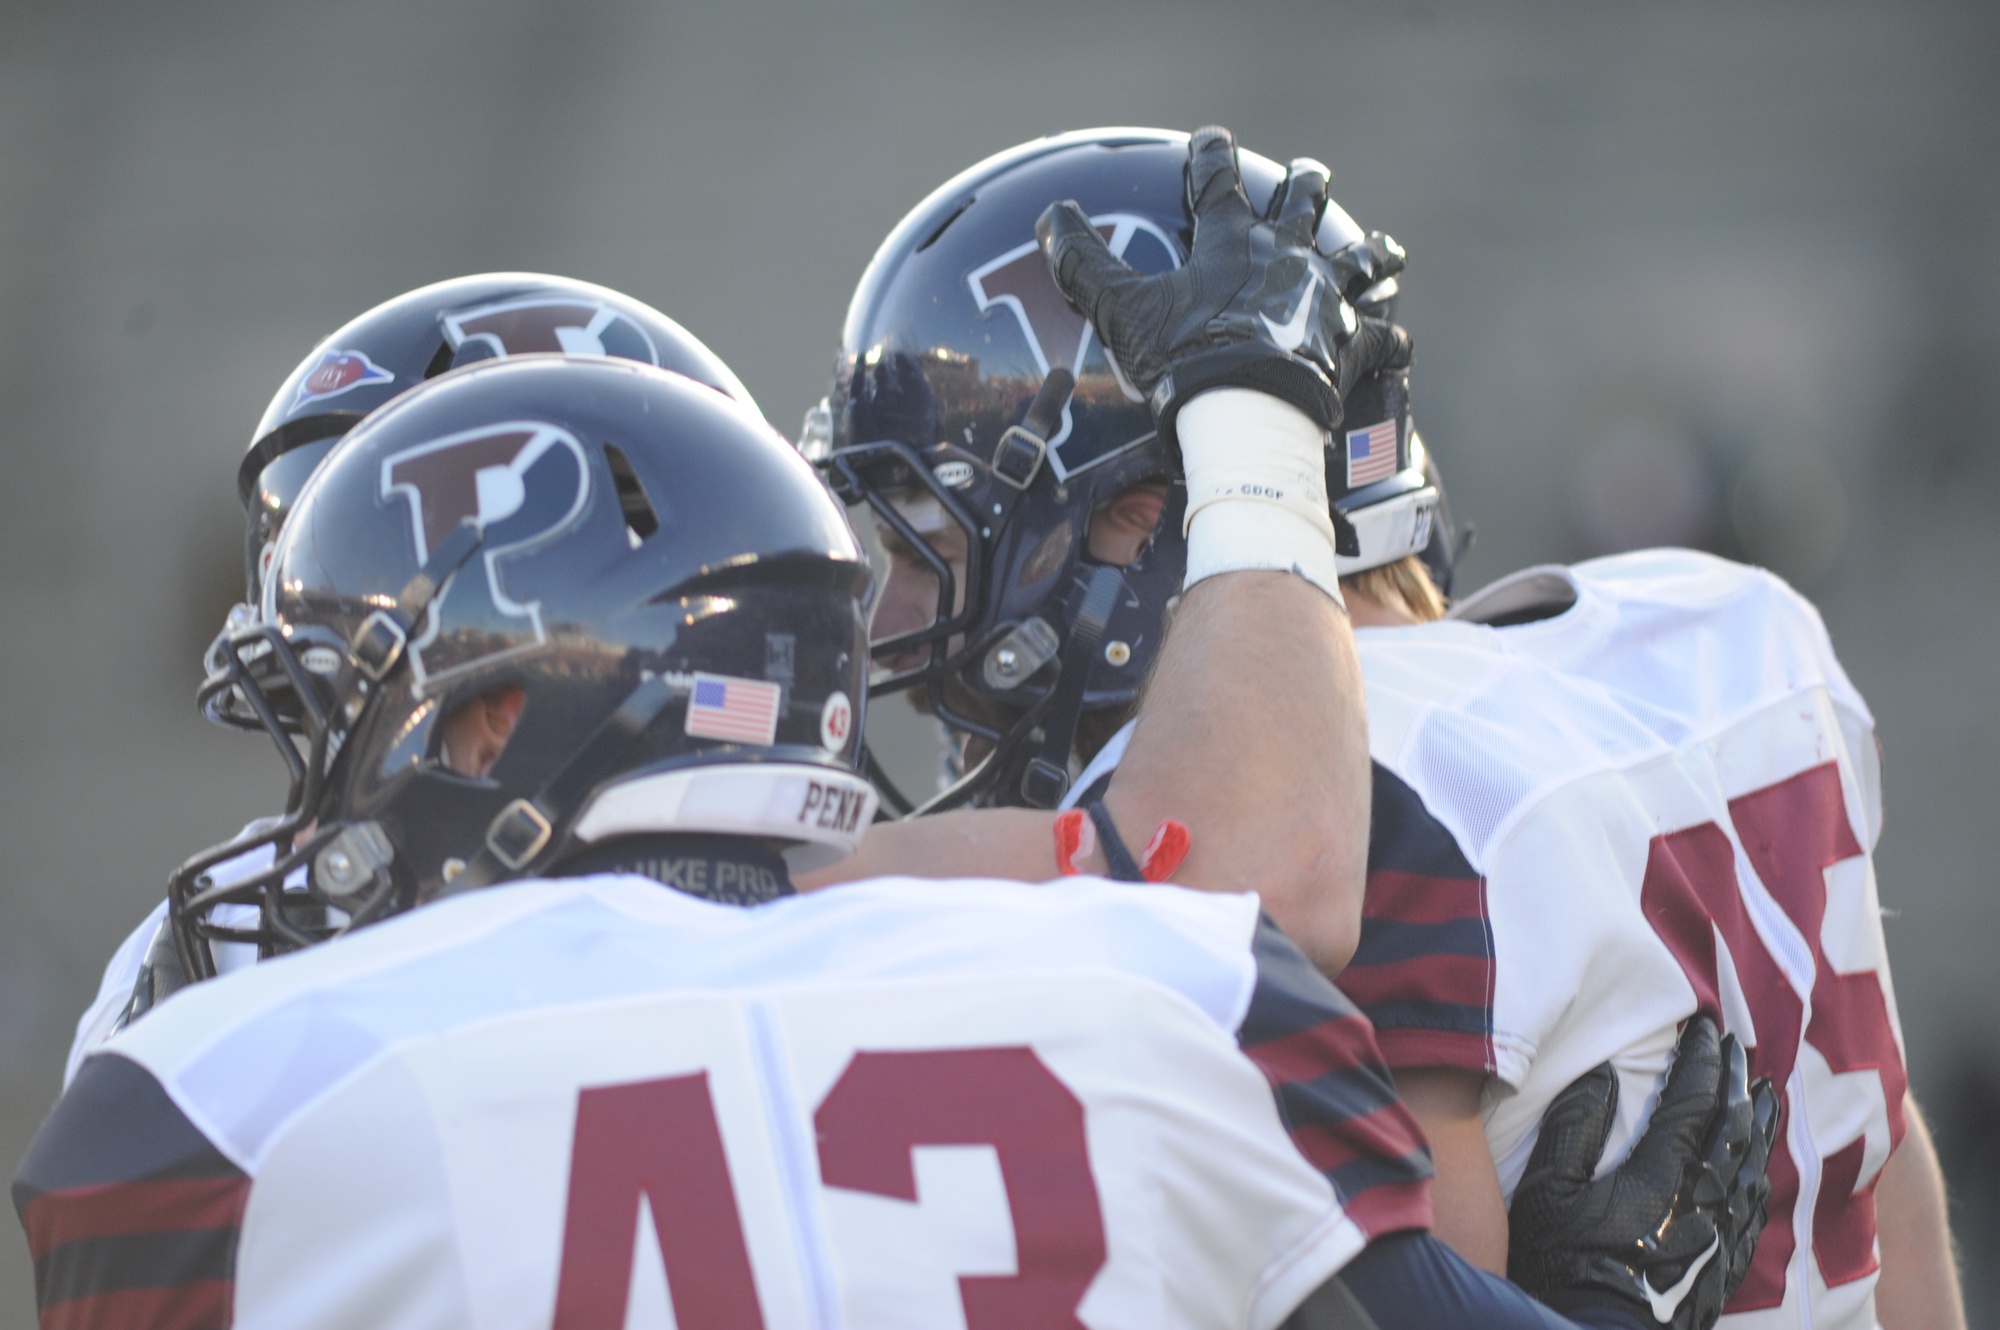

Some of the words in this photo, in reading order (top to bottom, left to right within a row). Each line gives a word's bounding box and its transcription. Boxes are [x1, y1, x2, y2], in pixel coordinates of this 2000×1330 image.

[380, 419, 592, 696] P
[828, 706, 848, 738] 43
[798, 779, 868, 833] PENN
[552, 1044, 1108, 1330] 43
